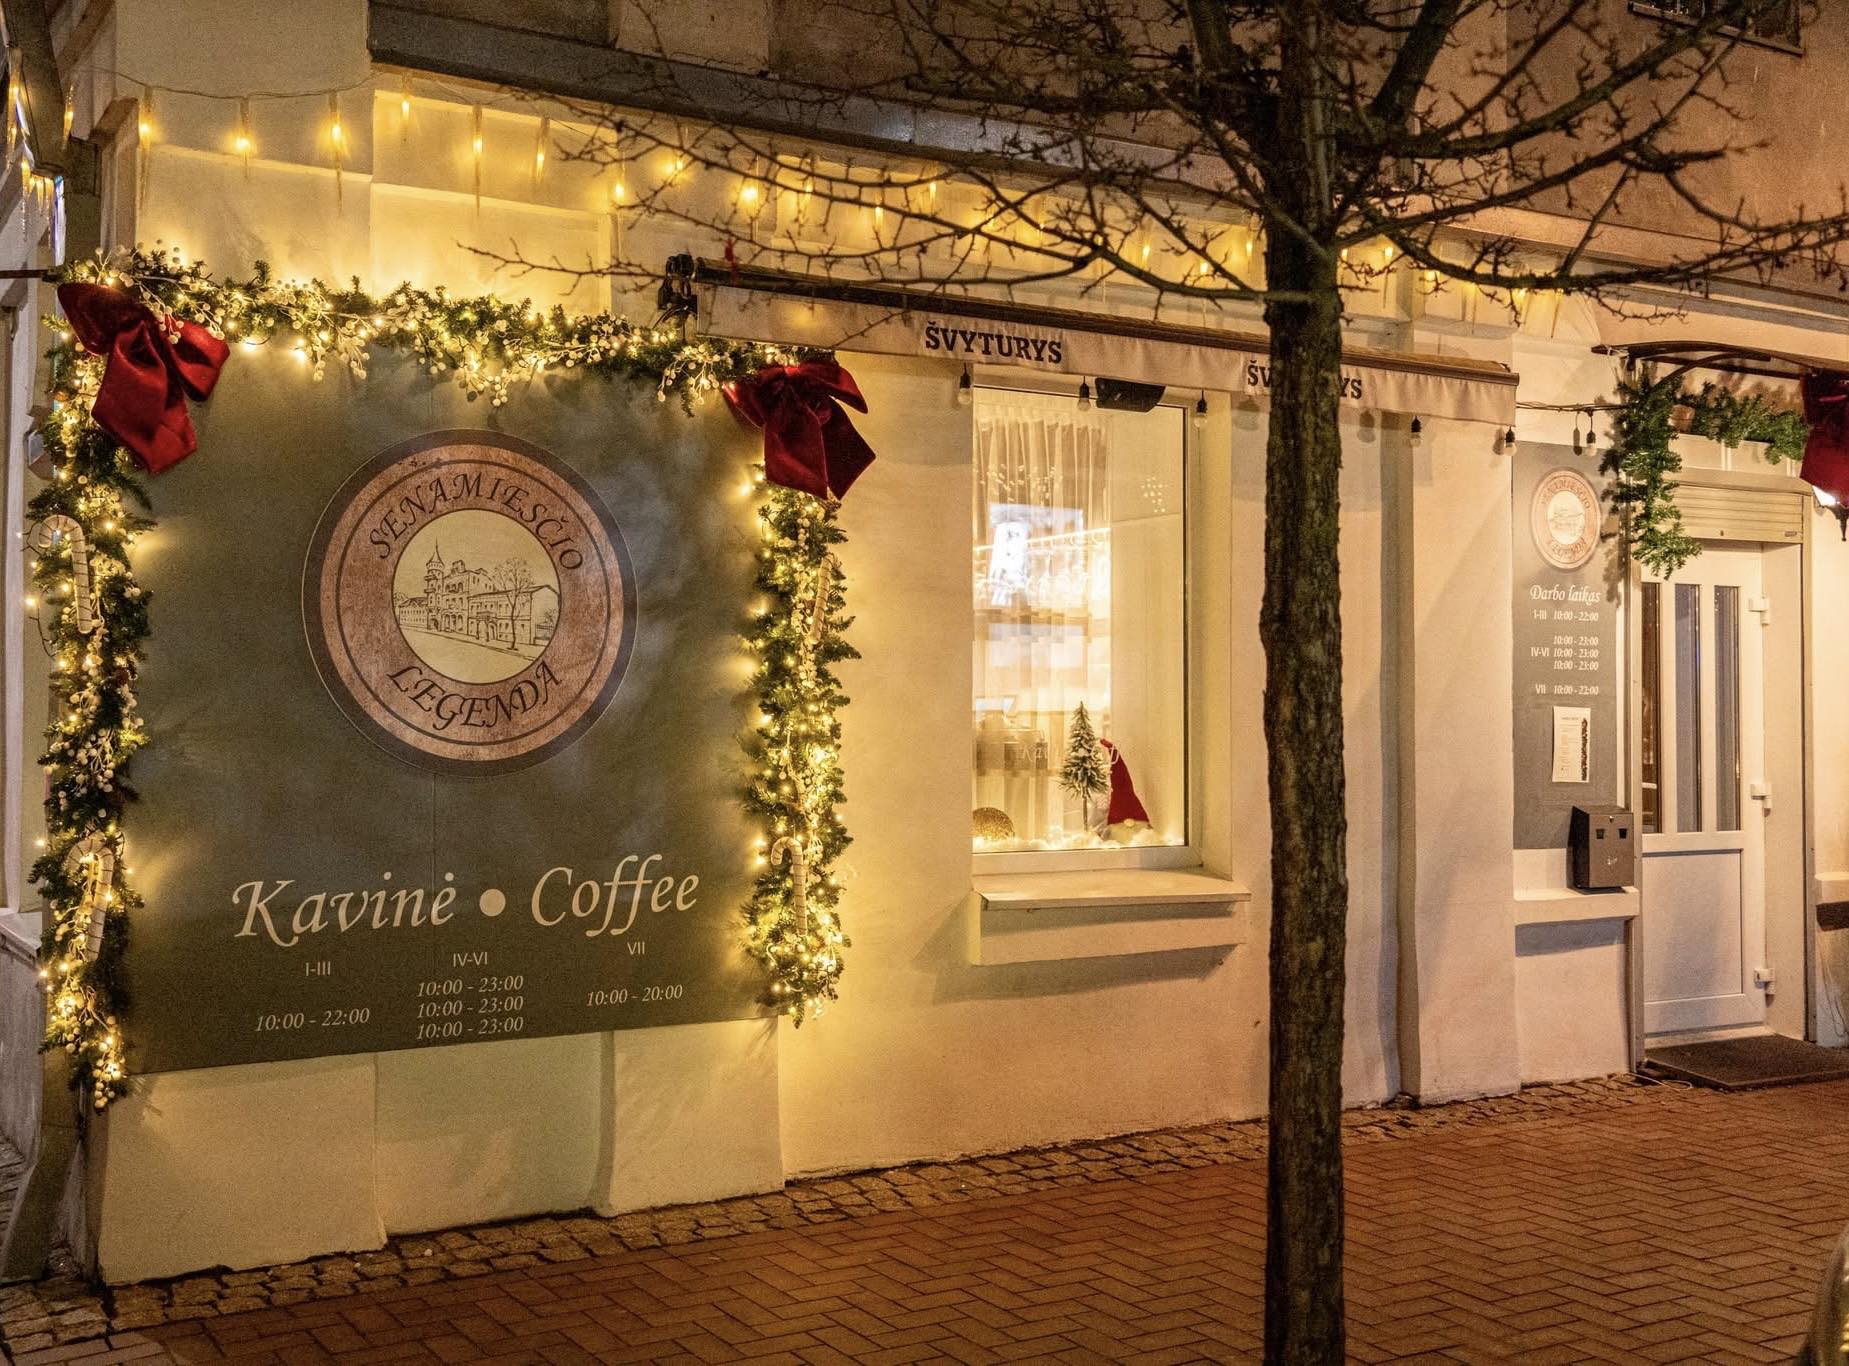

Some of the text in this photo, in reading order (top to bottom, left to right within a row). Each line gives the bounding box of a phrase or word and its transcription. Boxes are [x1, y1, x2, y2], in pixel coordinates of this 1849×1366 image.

[926, 321, 1061, 363] ŠVYTURYS
[1247, 359, 1362, 399] ŠVYS
[369, 472, 583, 571] SENAMIESČIO
[1530, 584, 1601, 605] Darbo laikas
[1533, 609, 1547, 620] I-III
[1553, 610, 1573, 620] 10:00
[1578, 611, 1599, 621] 22:00
[1553, 635, 1573, 645] 10:00
[1578, 636, 1599, 646] 23:00
[1531, 647, 1550, 657] IV-VI
[1553, 648, 1573, 657] 10:00
[1578, 648, 1599, 658] 23:00
[1553, 660, 1573, 670] 10:00
[1578, 661, 1599, 671] 23:00
[386, 660, 562, 730] LEGENDA
[1535, 684, 1546, 694] VII
[231, 853, 700, 948] Kavinė Coffee
[627, 941, 646, 955] VII
[305, 961, 331, 976] I-III
[453, 951, 489, 968] IV-VI
[417, 979, 463, 997] 10:00
[478, 975, 524, 993] 23:00
[586, 988, 628, 1007] 10:00
[642, 985, 683, 1002] 20:00
[417, 1000, 463, 1018] 10:00
[478, 995, 524, 1014] 23:00
[255, 1013, 304, 1032] 10:00
[321, 1008, 370, 1026] 22:00
[417, 1021, 463, 1040] 10:00
[478, 1016, 524, 1035] 23:00
